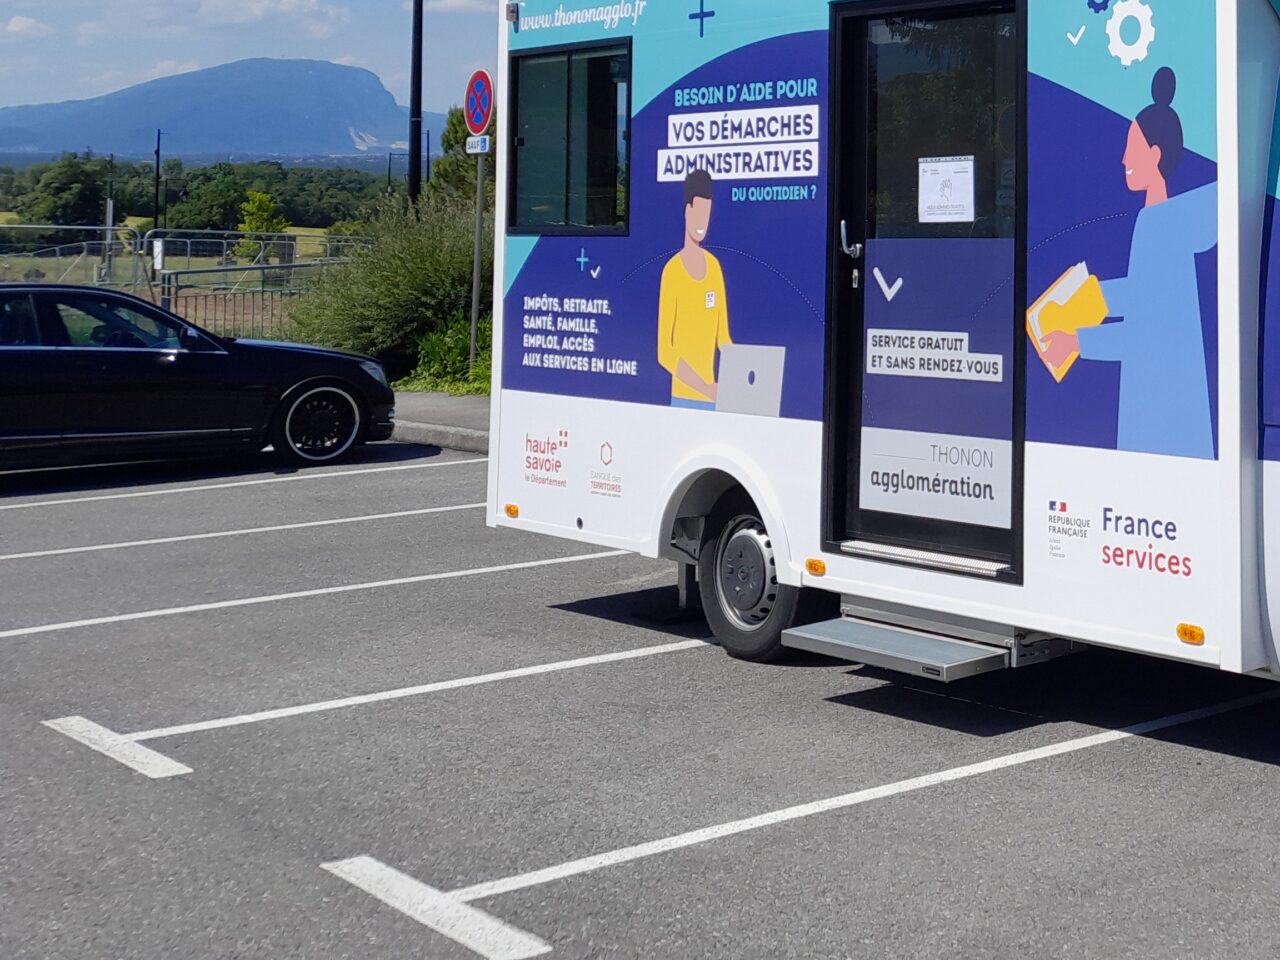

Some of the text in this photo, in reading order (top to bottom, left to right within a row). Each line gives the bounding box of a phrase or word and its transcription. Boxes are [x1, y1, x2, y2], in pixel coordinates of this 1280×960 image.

[674, 78, 818, 107] BESOIN D'AIDE POUR
[672, 113, 813, 142] VOS DÉMARCHES
[663, 149, 813, 175] ADMINISTRATIVES
[732, 185, 817, 201] DU QUOTIDIEN ?
[523, 293, 611, 315] IMPÔTS, RETRAITE,
[523, 313, 599, 334] SANTÉ, FAMILLE,
[523, 333, 594, 352] EMPLOI, ACCÈS
[871, 334, 965, 351] SERVICE GRATUIT
[522, 352, 638, 376] AUX SERVICES EN LIGNE
[871, 355, 999, 375] ET SANS RENDEZ-VOUS
[525, 432, 557, 455] haute
[525, 455, 562, 473] savoie
[930, 444, 994, 469] THONON
[871, 469, 995, 501] agglomération
[1102, 507, 1177, 541] France
[1102, 543, 1192, 577] services
